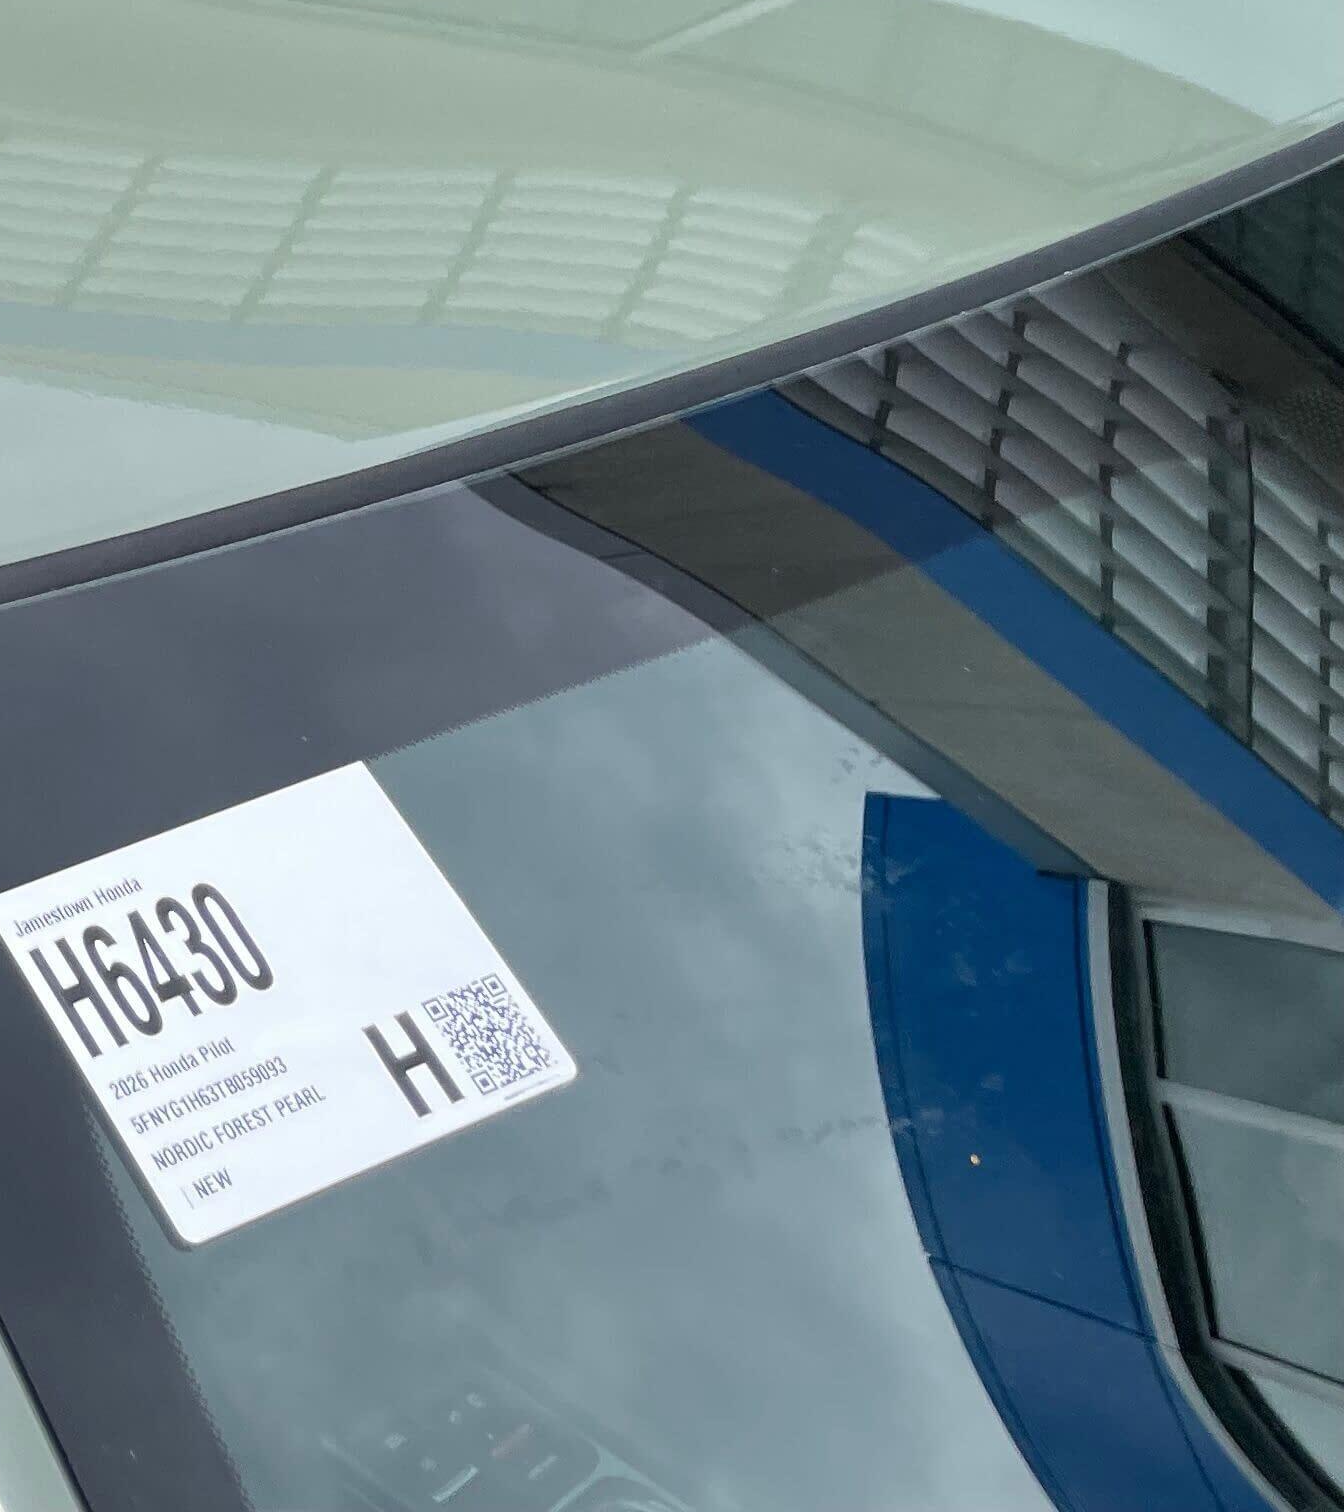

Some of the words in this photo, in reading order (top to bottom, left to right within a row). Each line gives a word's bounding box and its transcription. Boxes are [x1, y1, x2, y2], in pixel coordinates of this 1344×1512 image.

[14, 896, 94, 937] Jamestown
[93, 876, 143, 906] Honda
[29, 883, 273, 1058] H6430
[110, 1070, 149, 1100] 2026
[148, 1053, 199, 1084] Honda
[198, 1037, 236, 1063] Pilot
[129, 1056, 288, 1135] 5FNYG1H63TB059093
[362, 1010, 465, 1118] H
[150, 1131, 214, 1171] NORDIC
[212, 1104, 273, 1144] FOREST
[273, 1085, 327, 1118] PEARL
[192, 1167, 233, 1199] NEW
